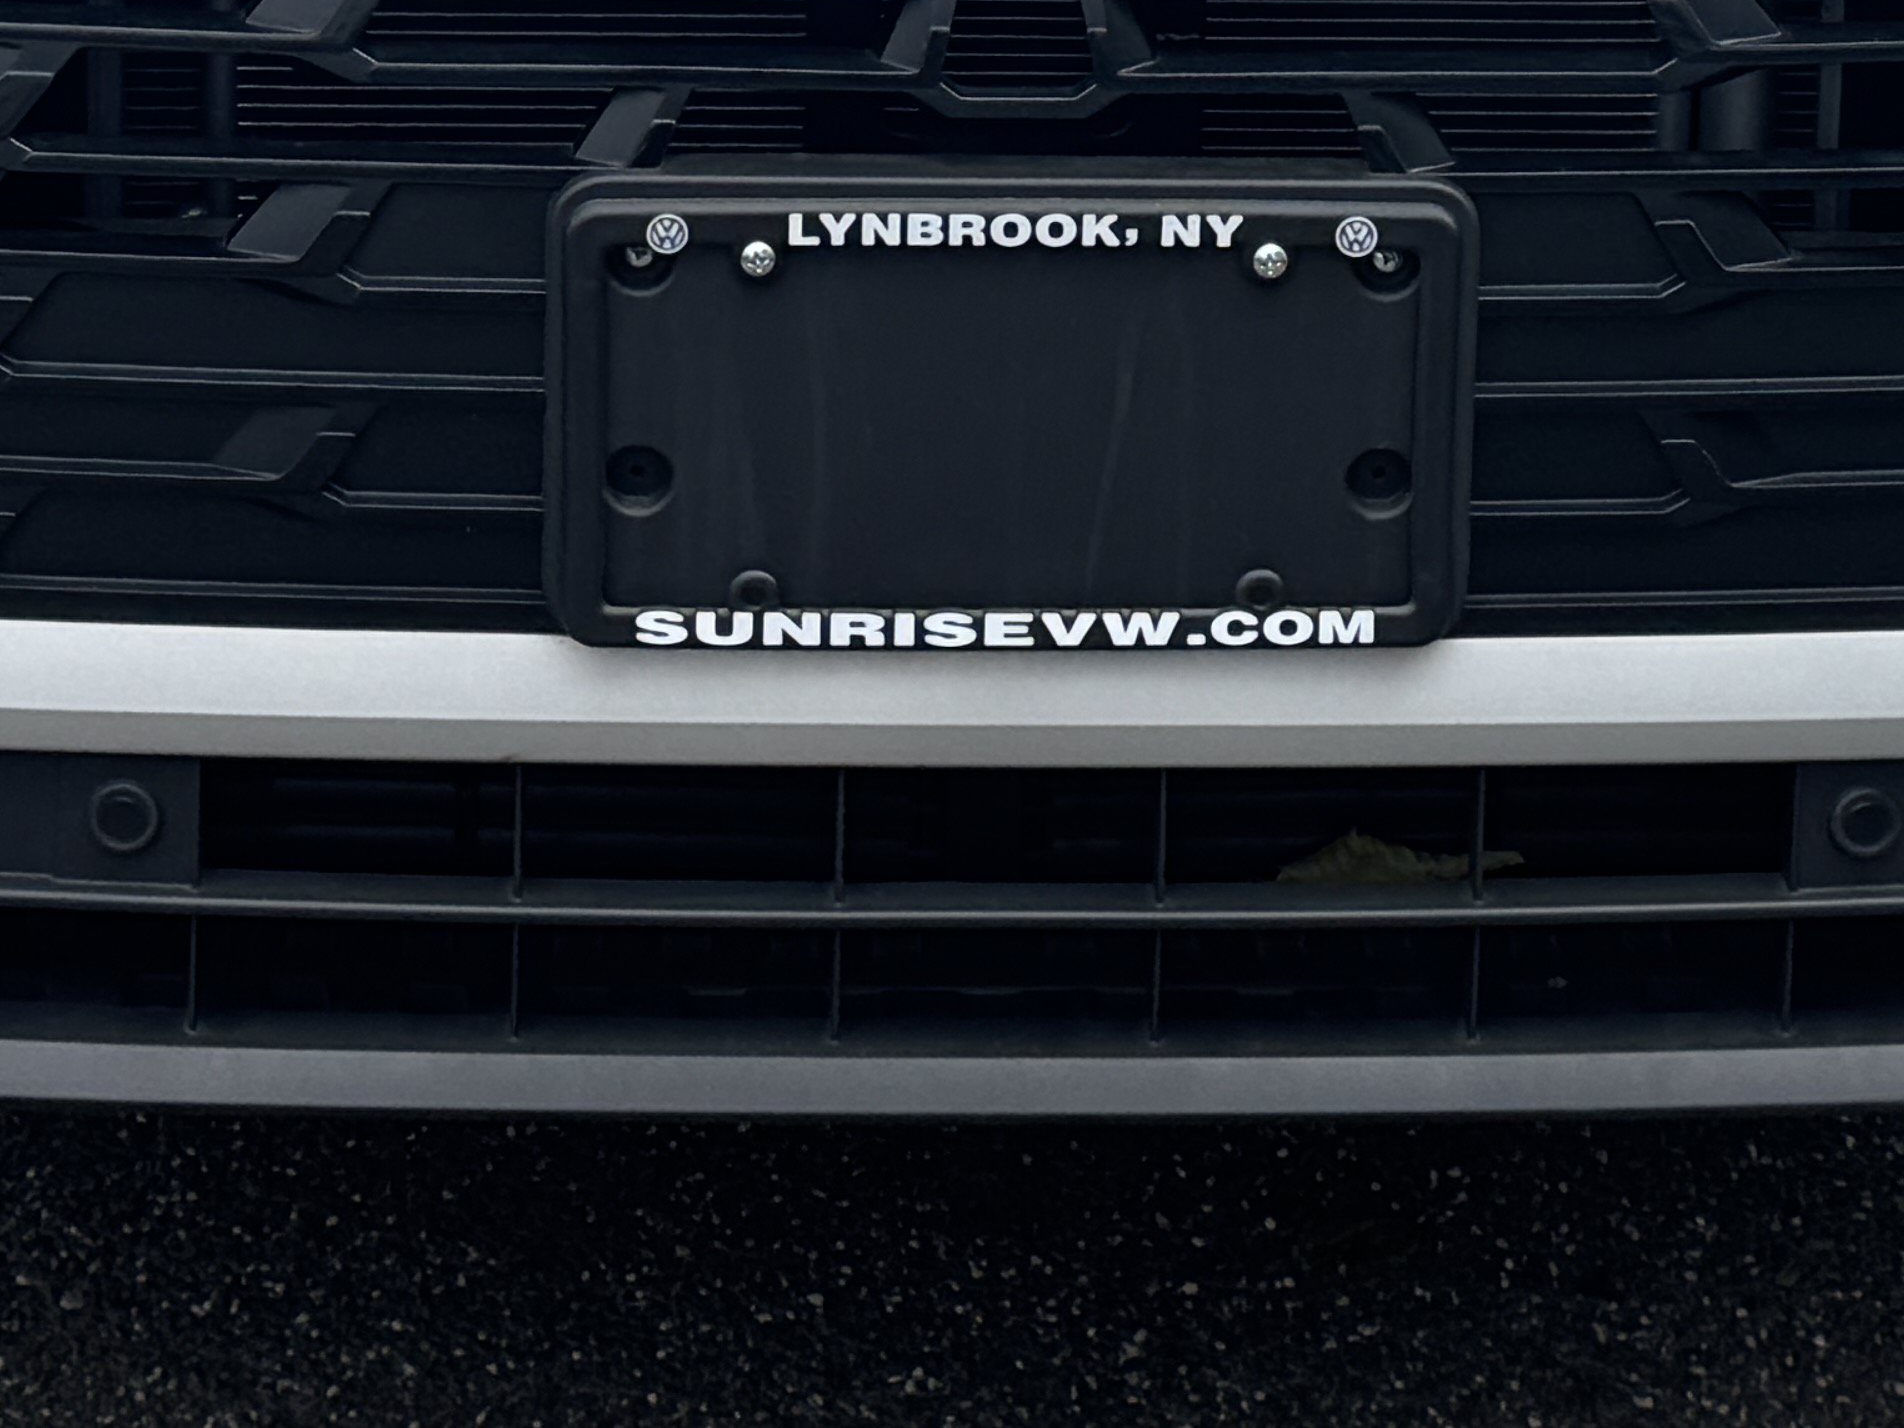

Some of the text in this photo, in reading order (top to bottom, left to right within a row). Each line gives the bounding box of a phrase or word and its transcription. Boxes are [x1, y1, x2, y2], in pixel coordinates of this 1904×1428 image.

[788, 213, 1244, 248] LYNBROOK, NY
[635, 609, 1375, 647] SUNRISEVW.COM
